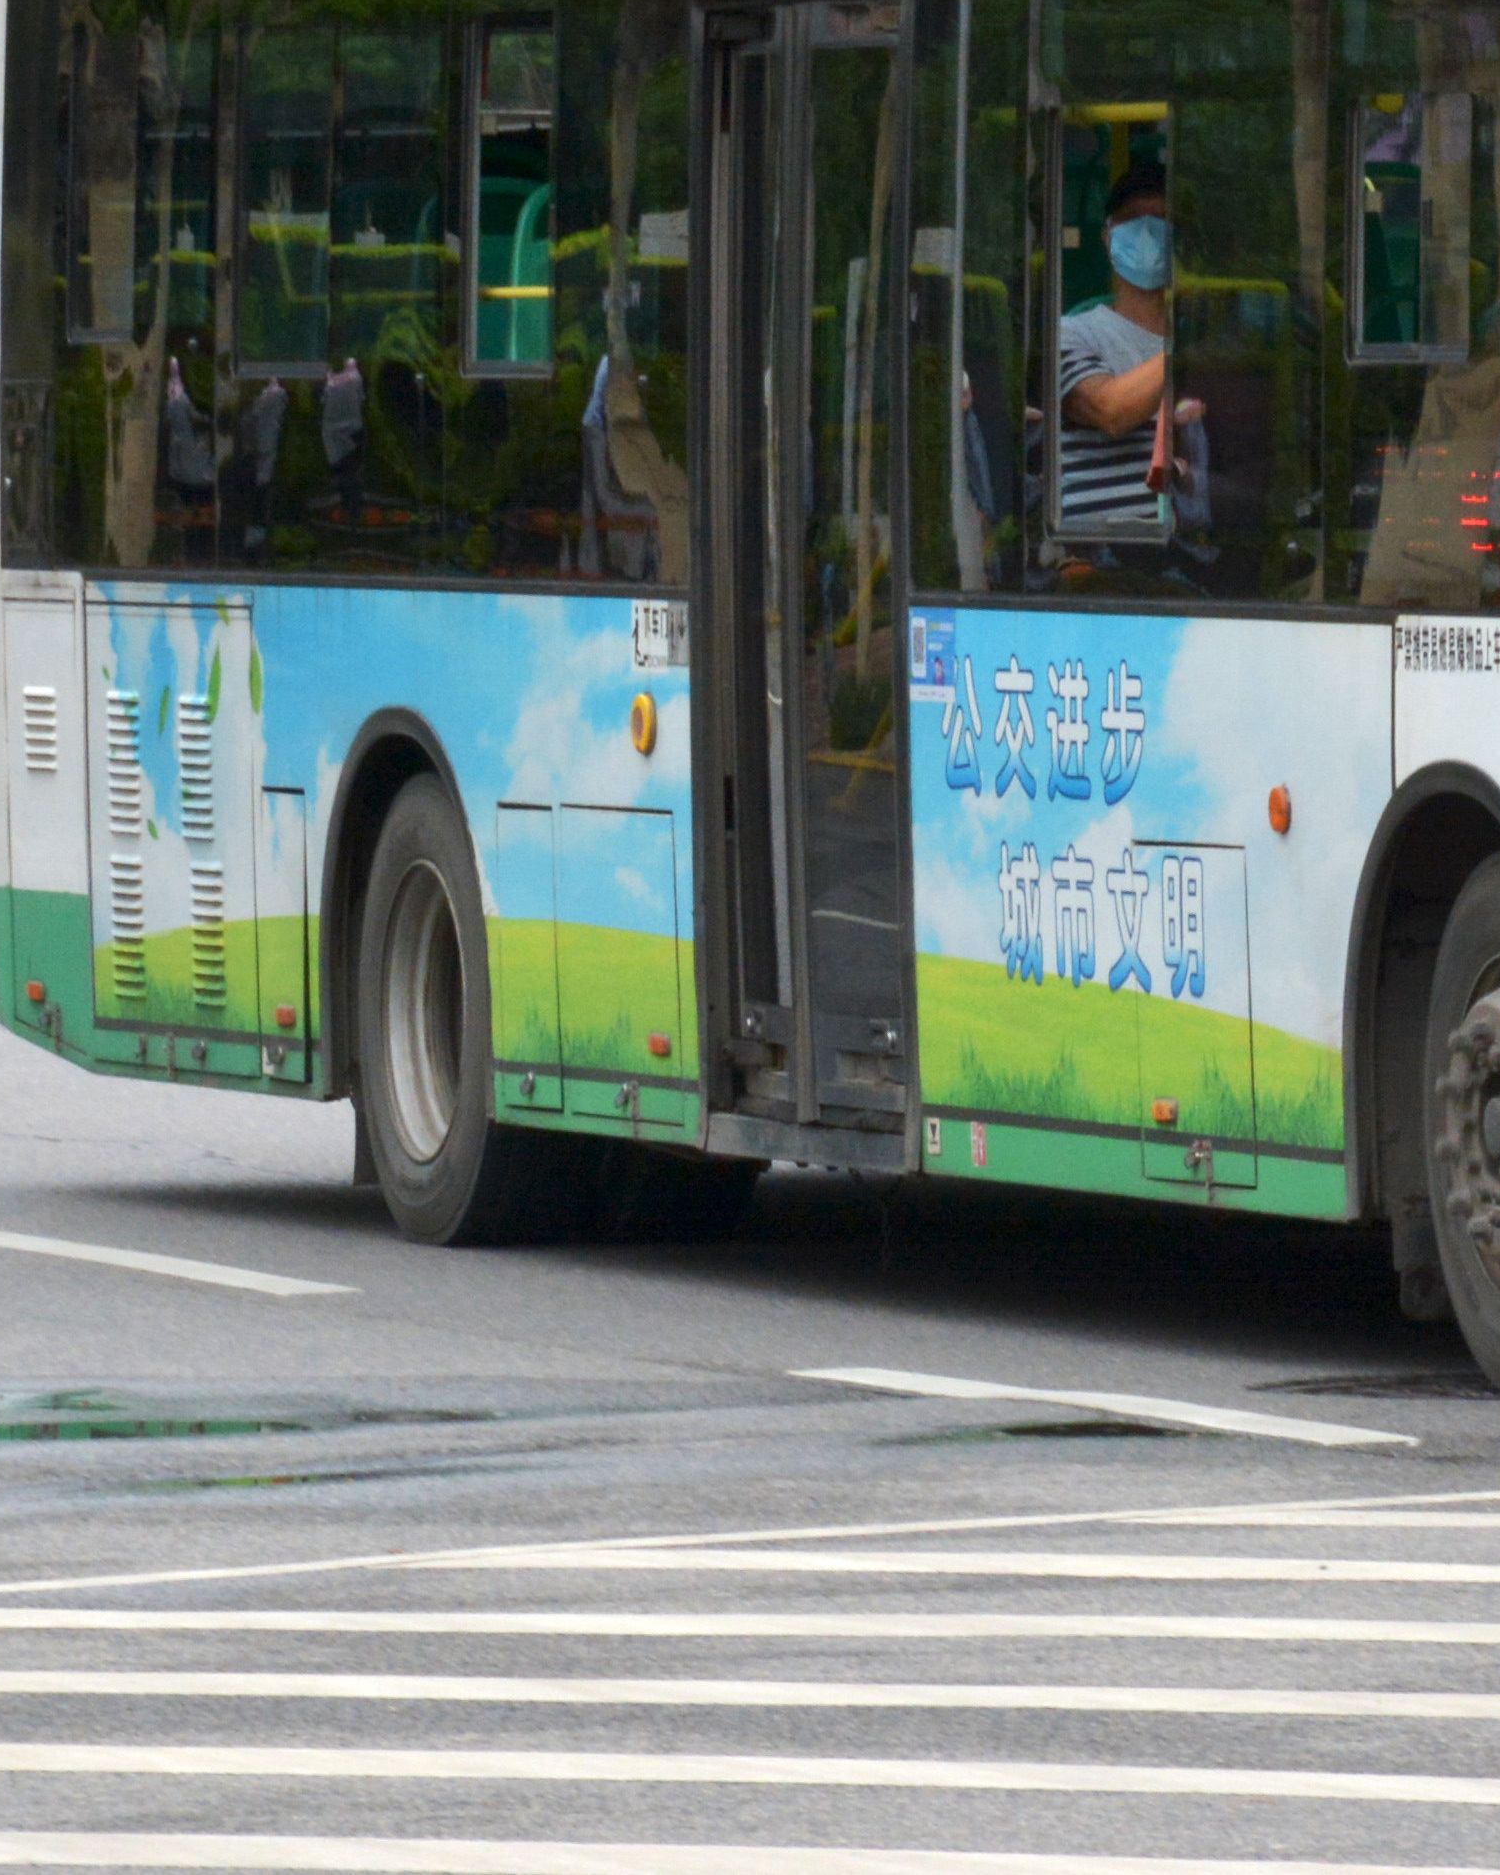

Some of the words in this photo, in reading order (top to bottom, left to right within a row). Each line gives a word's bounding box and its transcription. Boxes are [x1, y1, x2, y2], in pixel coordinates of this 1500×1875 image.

[942, 653, 1145, 806] 公交进步
[998, 840, 1205, 999] 城市文明
